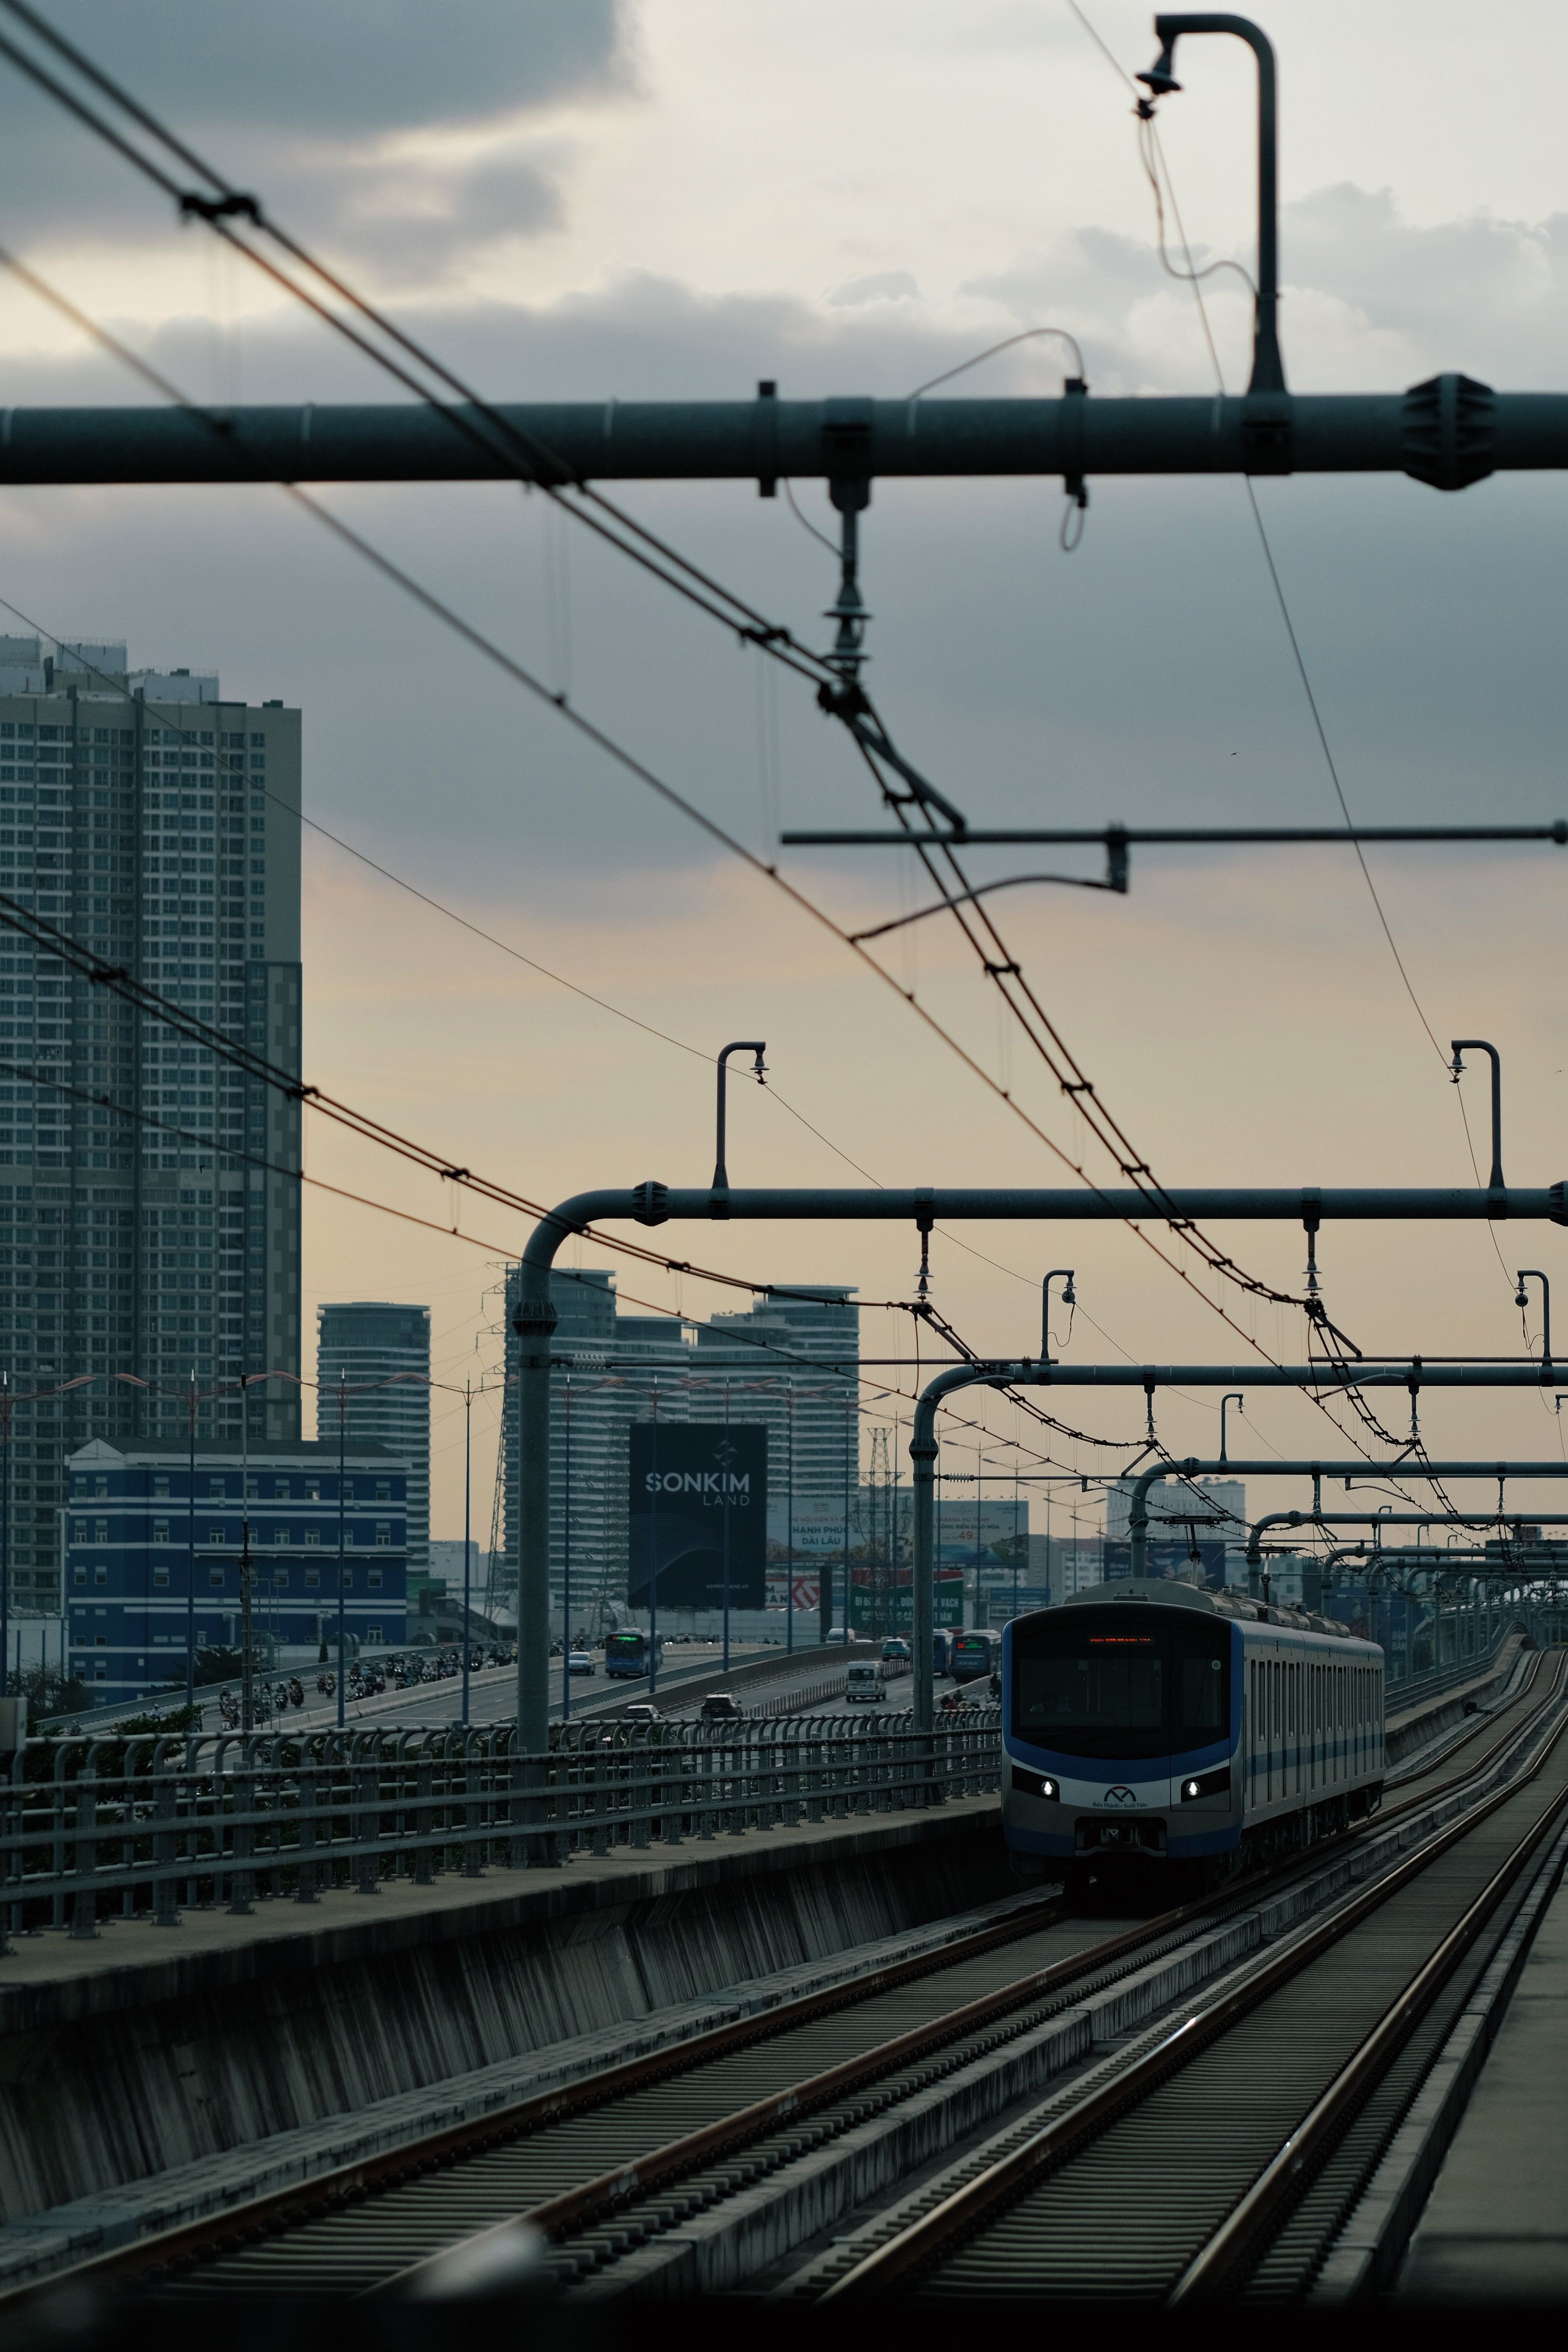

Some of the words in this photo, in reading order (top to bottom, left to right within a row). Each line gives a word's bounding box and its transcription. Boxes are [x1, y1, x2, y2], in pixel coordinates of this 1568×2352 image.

[646, 1472, 749, 1492] SONKIM
[704, 1495, 750, 1506] LAND
[793, 1526, 821, 1535] HẠNH
[959, 1531, 973, 1540] 49
